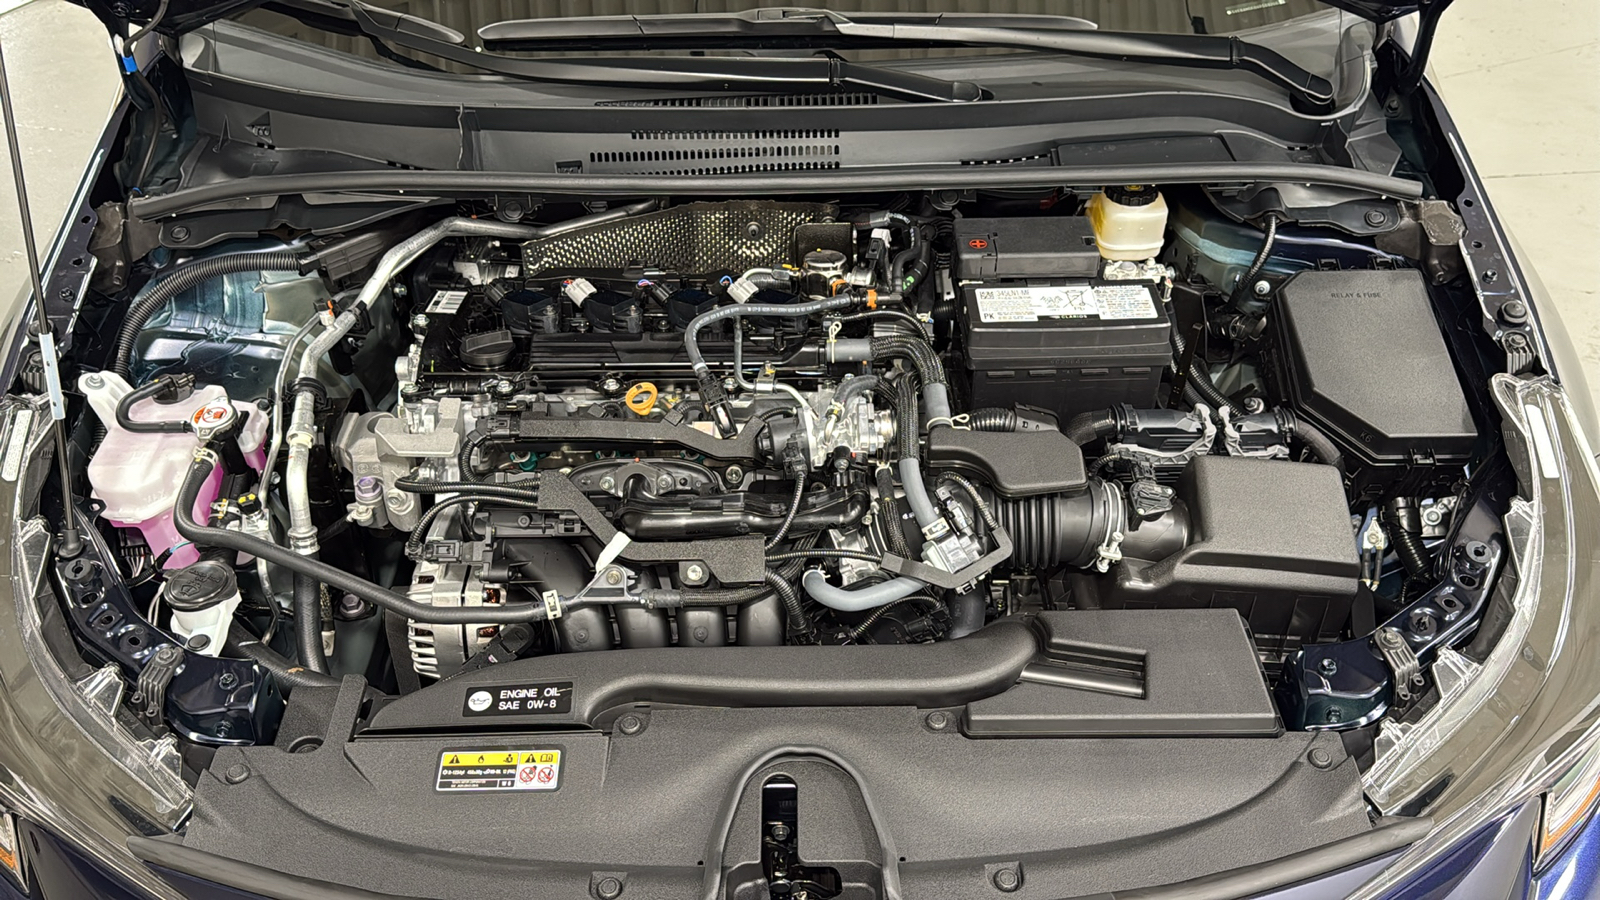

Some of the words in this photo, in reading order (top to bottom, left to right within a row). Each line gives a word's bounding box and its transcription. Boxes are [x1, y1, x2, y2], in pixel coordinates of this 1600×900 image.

[983, 312, 995, 320] PK
[500, 688, 538, 699] ENGINE
[544, 687, 561, 697] OIL
[498, 700, 520, 710] SAE
[527, 699, 557, 710] 0W-8
